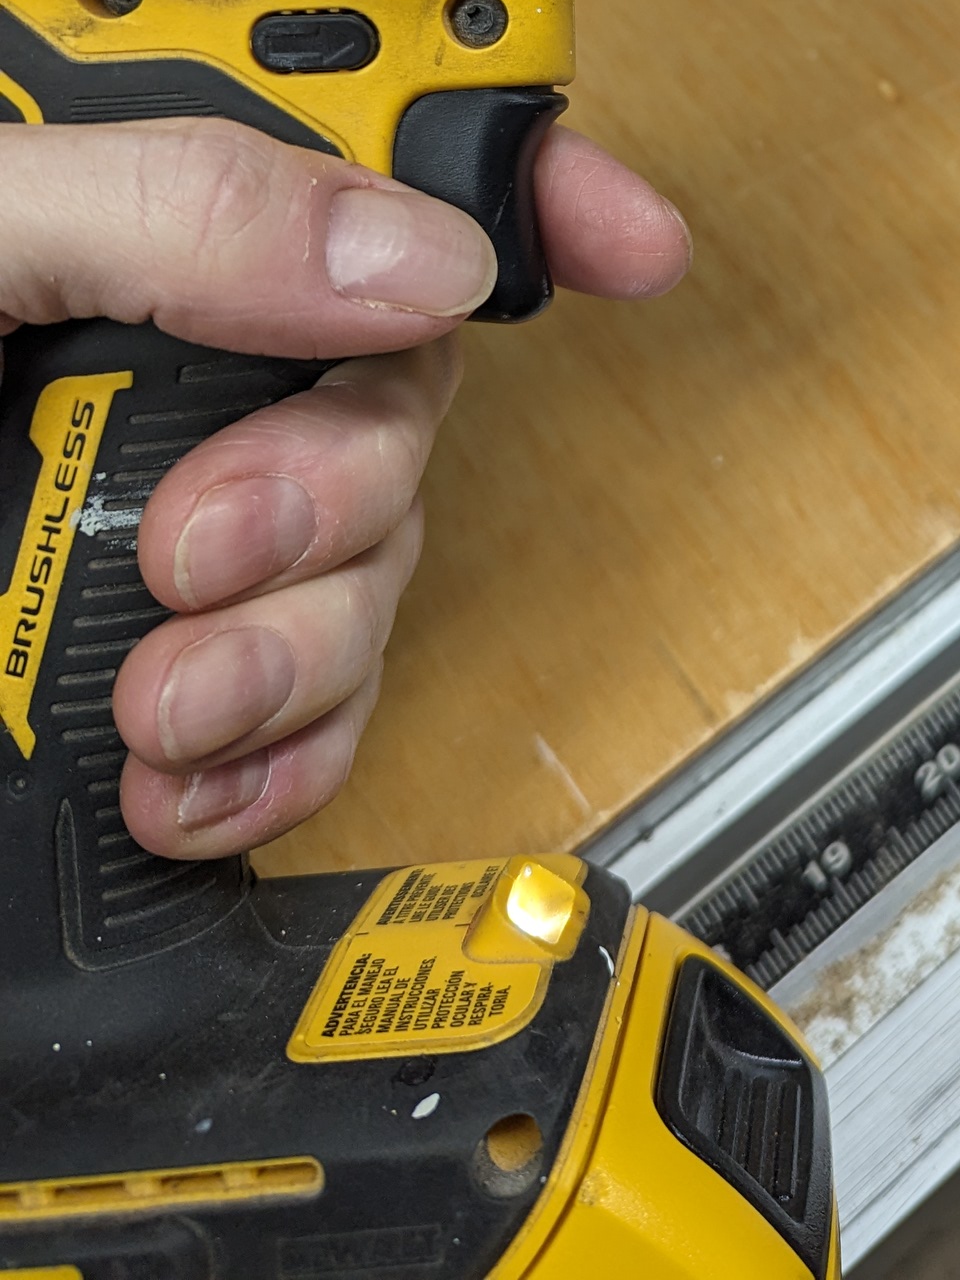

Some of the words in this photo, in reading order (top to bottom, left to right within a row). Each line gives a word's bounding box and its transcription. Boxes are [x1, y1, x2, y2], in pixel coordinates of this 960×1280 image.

[6, 399, 95, 679] BRUSHLESS
[803, 841, 853, 892] 19
[357, 958, 386, 996] MANEJO
[374, 977, 394, 994] LEA
[382, 966, 399, 977] EL
[321, 953, 372, 1037] ADVERTENCIA:
[351, 997, 368, 1008] EL
[375, 990, 405, 1033] MANUAL
[394, 977, 411, 990] DE
[393, 955, 437, 1032] INSTRUCCIONES.
[412, 988, 441, 1031] UTILIZAR
[431, 970, 465, 1029] PROTECCIÓN
[449, 989, 475, 1028] OCULAR
[468, 982, 494, 1026] RESPIRA-
[488, 985, 511, 1017] TORIA.
[338, 1009, 362, 1036] PARA
[357, 996, 385, 1034] SEGURO
